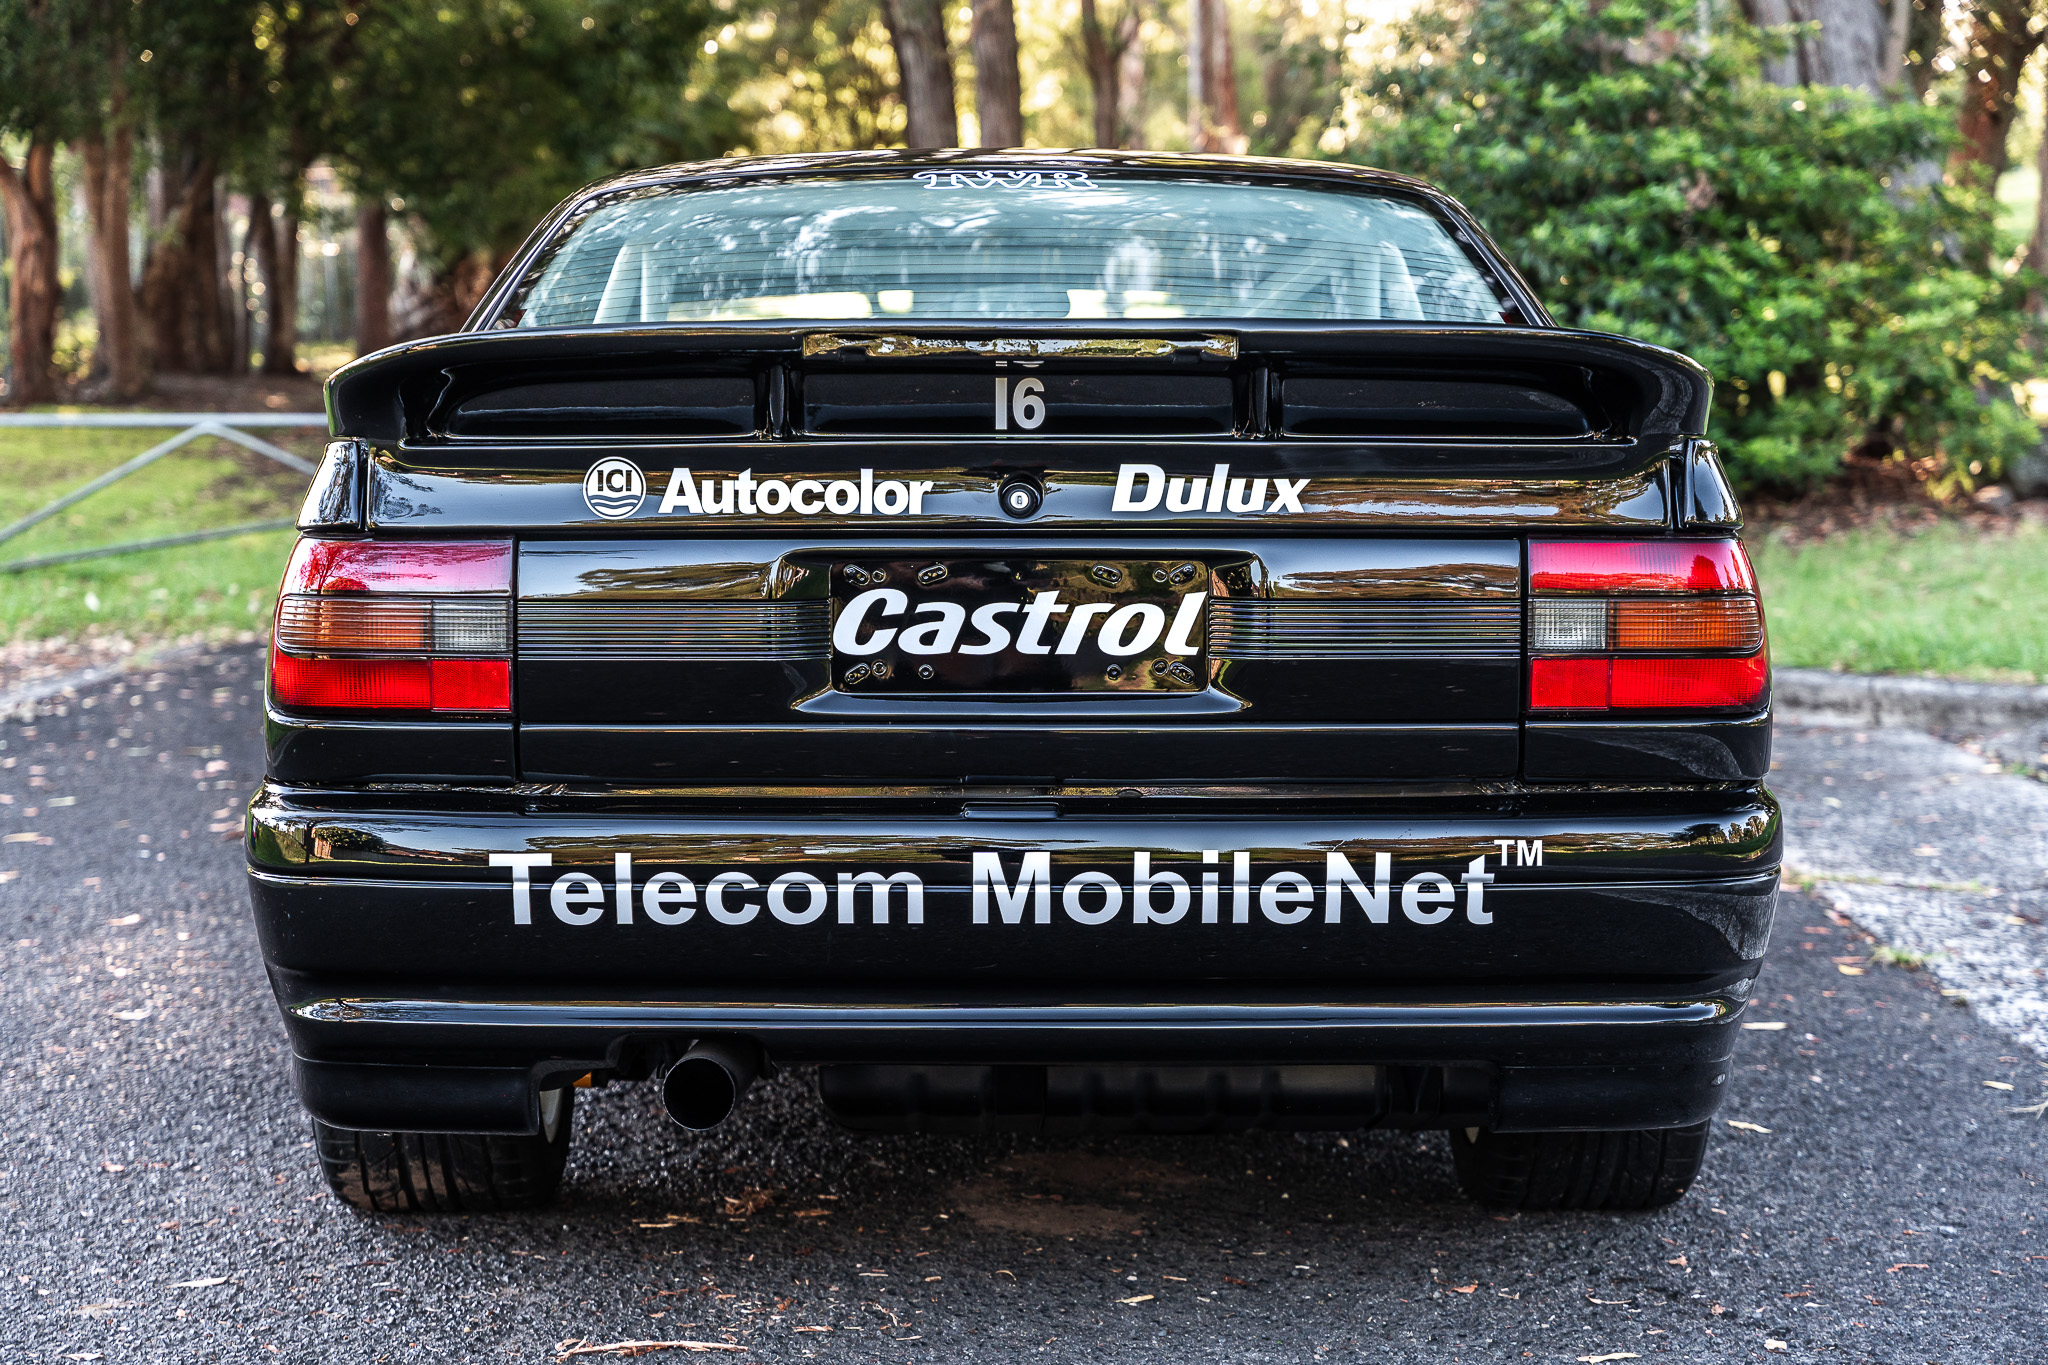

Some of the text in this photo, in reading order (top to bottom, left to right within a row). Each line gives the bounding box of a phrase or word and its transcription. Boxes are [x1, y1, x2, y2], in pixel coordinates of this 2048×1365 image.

[912, 169, 1099, 190] TWR
[995, 377, 1046, 430] 16
[596, 466, 935, 515] ICI Autocolor
[1111, 463, 1312, 513] Dulux
[832, 587, 1209, 657] Castrol
[488, 852, 925, 926] Telecom
